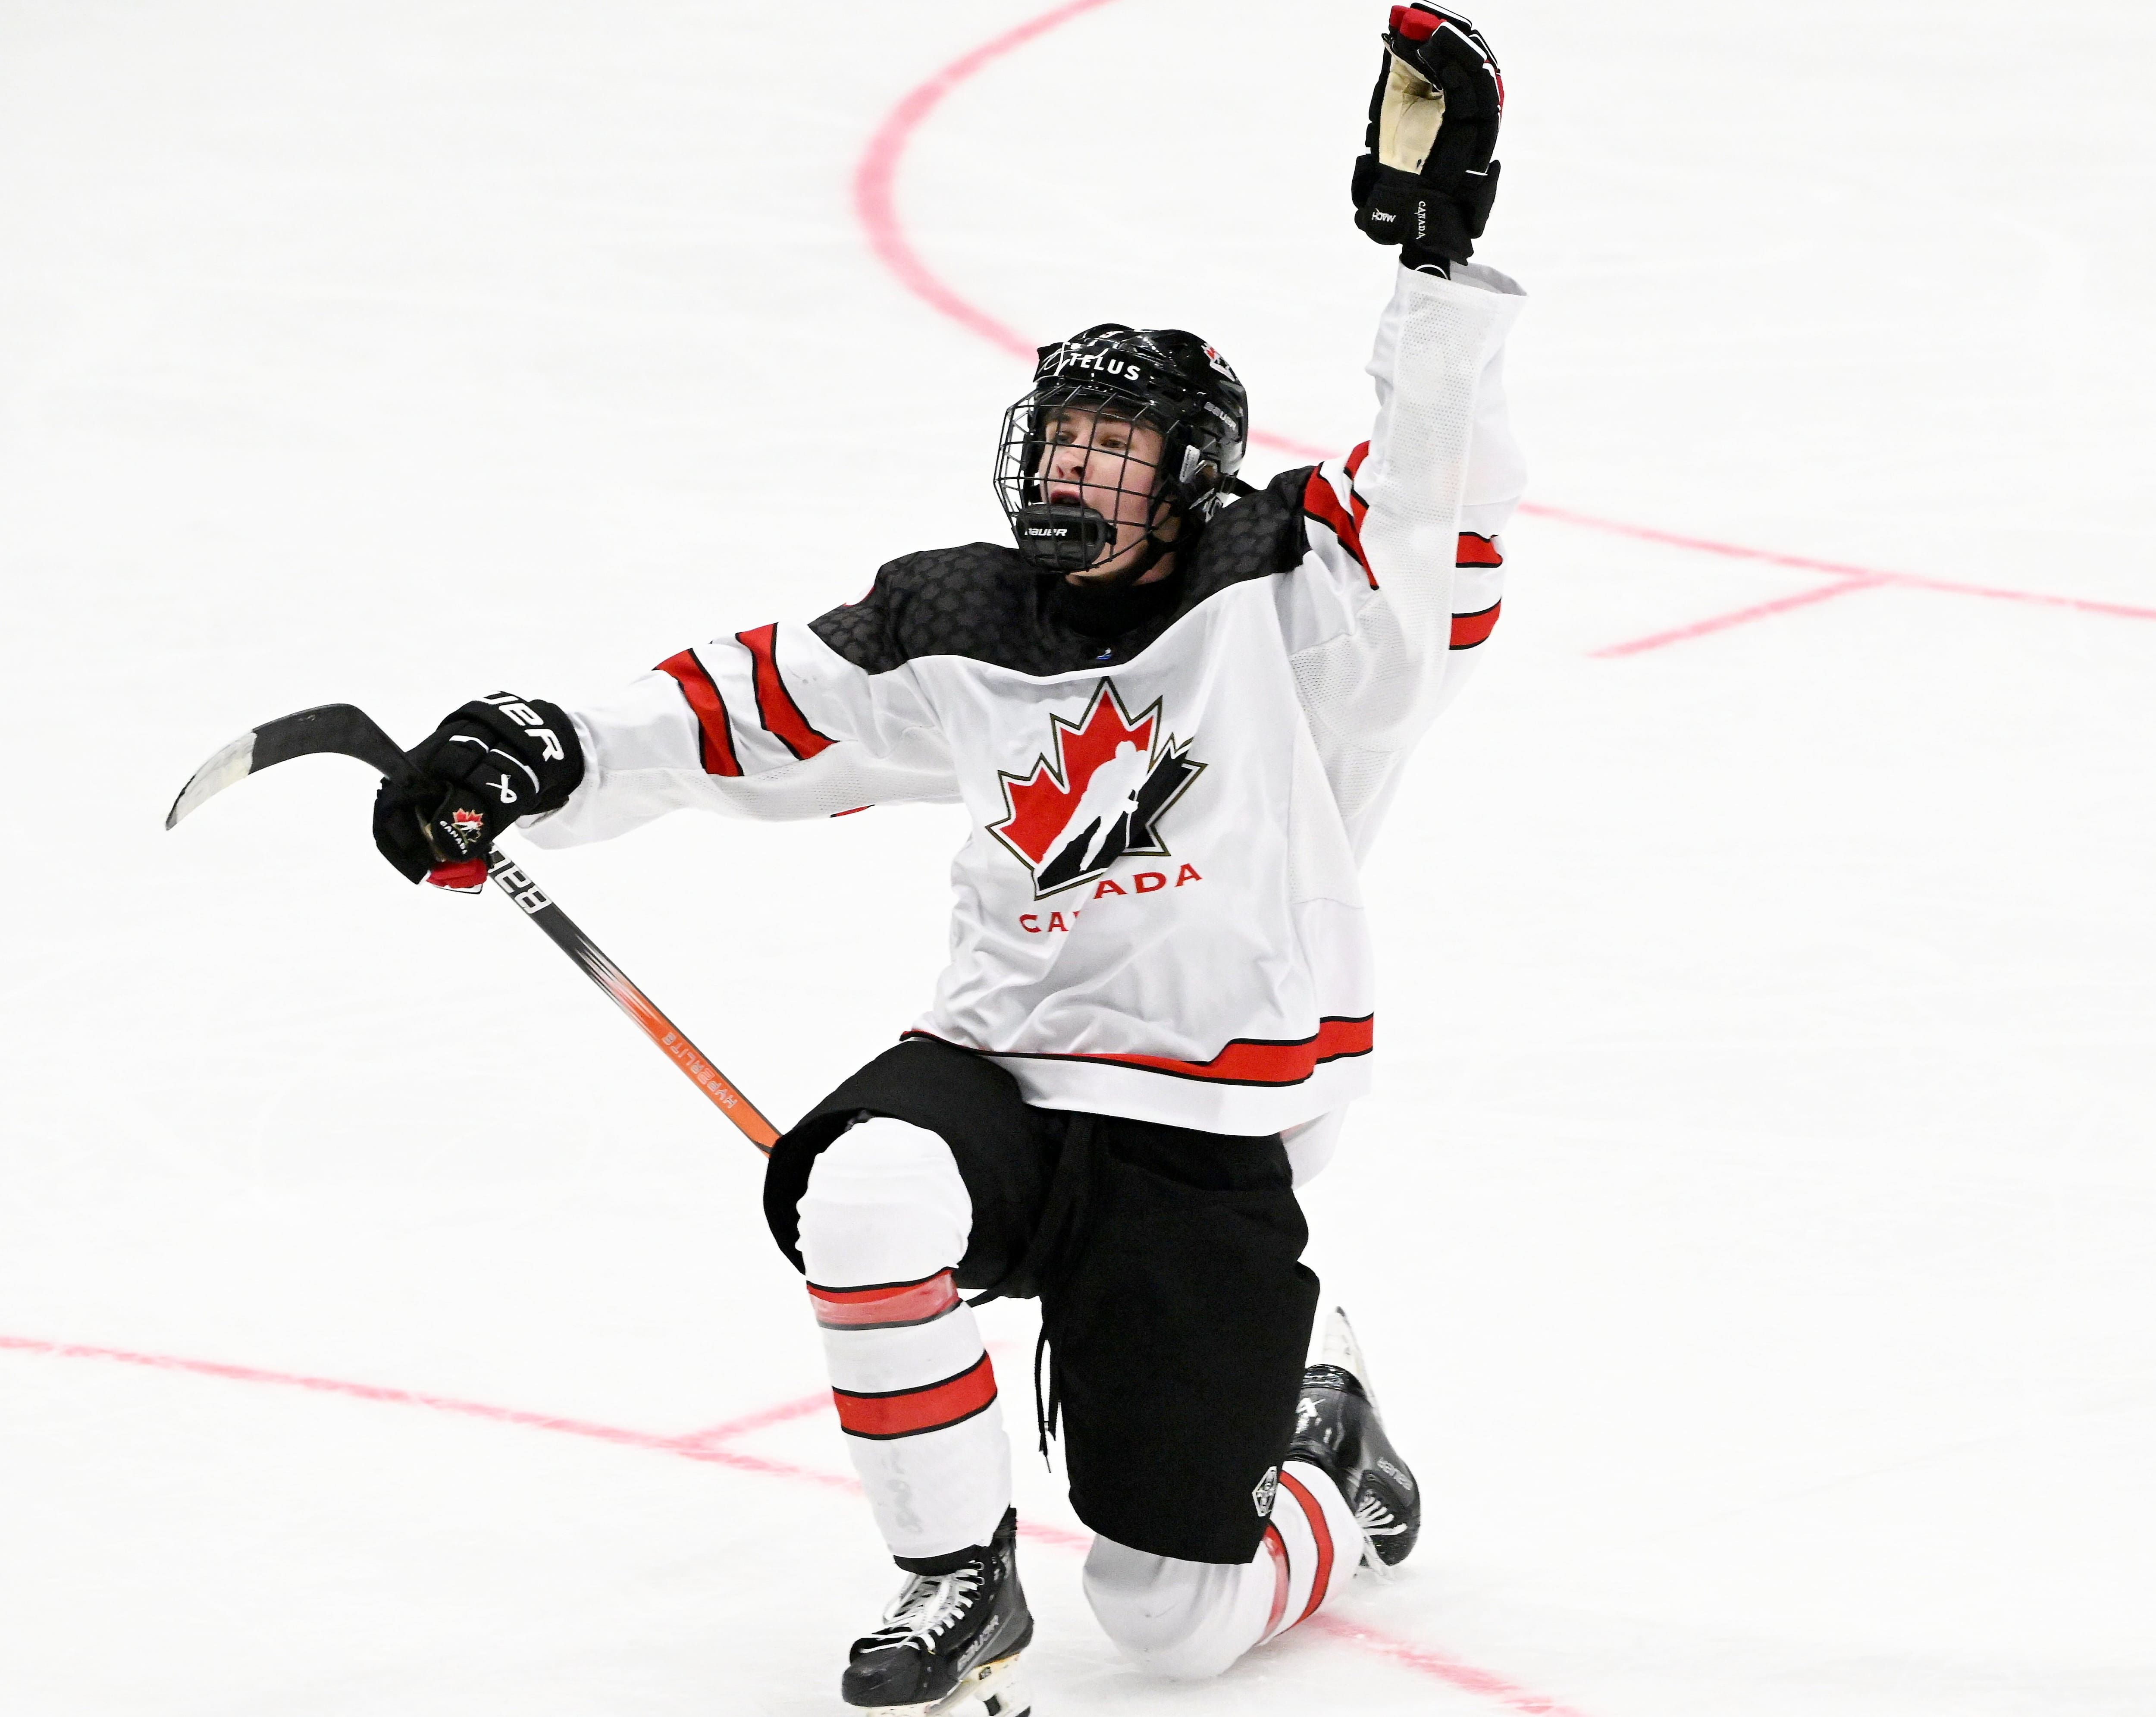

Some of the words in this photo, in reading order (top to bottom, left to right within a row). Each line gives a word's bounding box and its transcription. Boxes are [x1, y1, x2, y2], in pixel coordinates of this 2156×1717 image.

[1371, 210, 1397, 223] MACH
[1415, 201, 1426, 239] CANADA
[1069, 352, 1141, 380] TELUS
[439, 820, 468, 854] CANADA
[1019, 863, 1203, 933] CAADA
